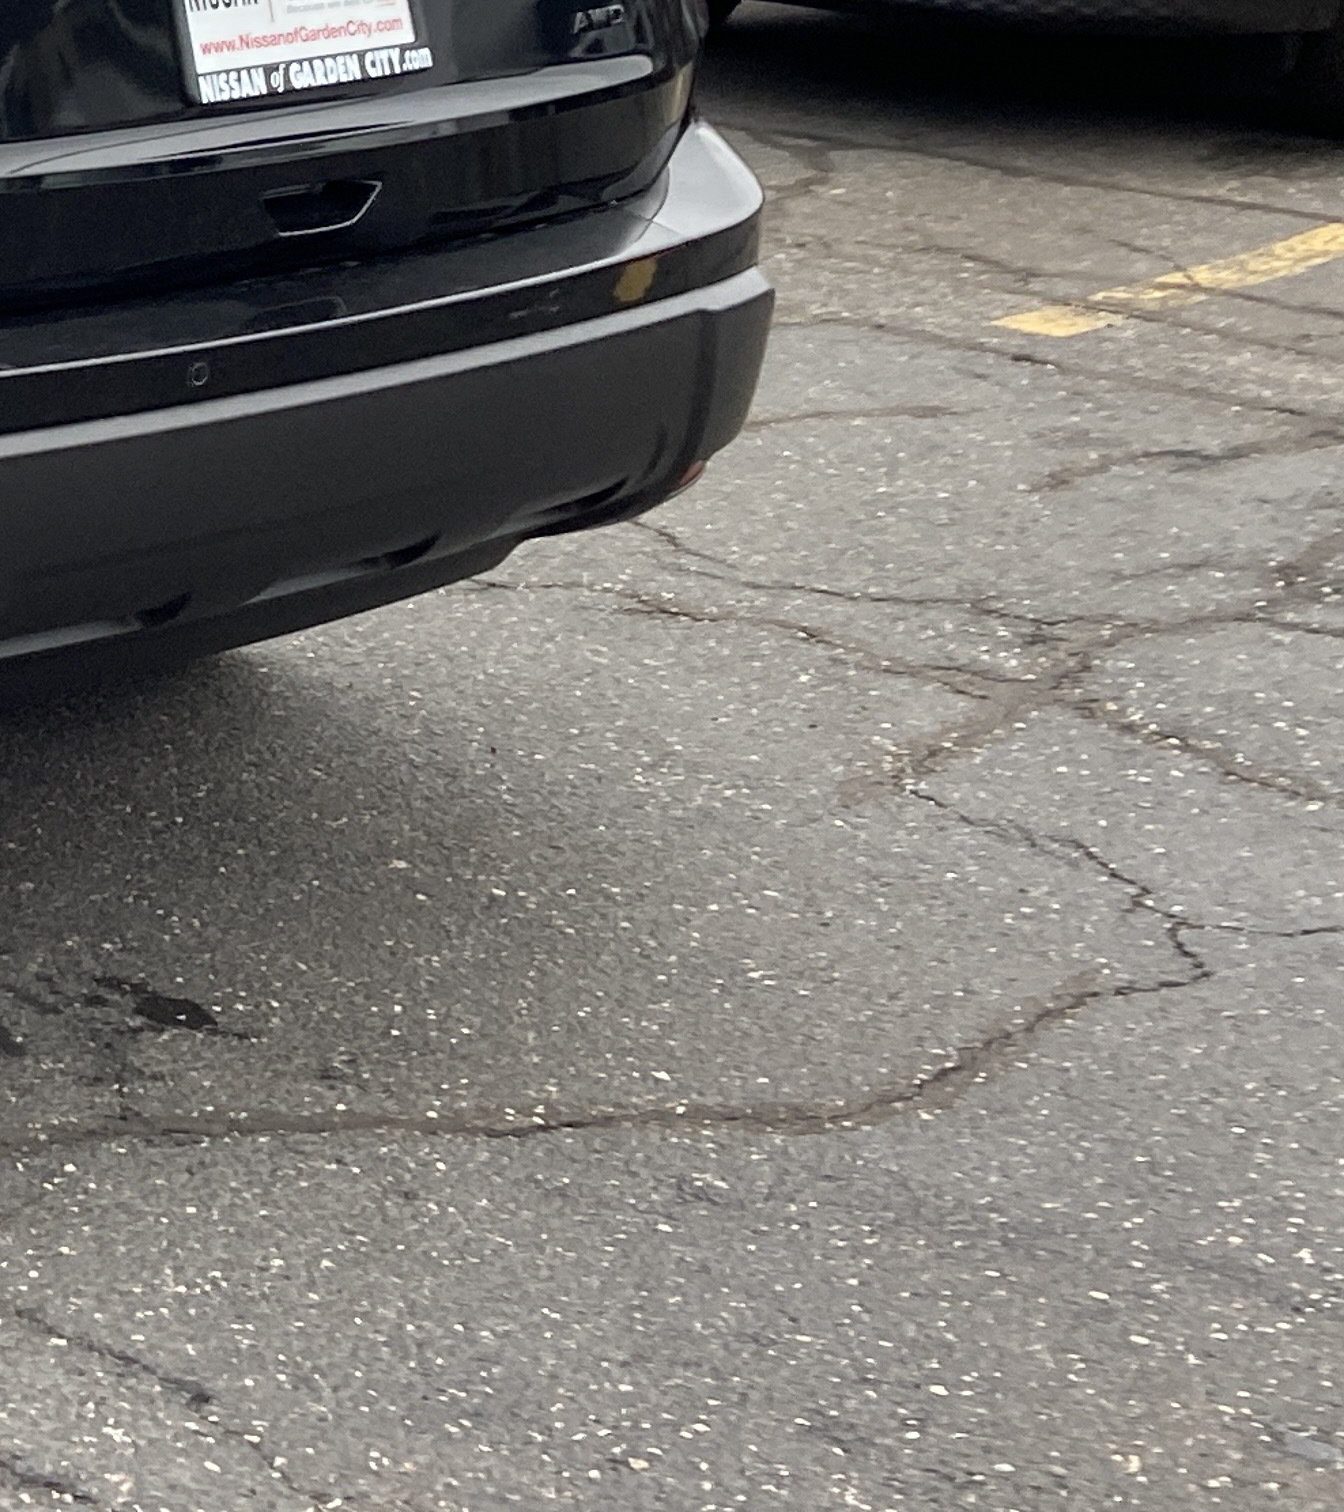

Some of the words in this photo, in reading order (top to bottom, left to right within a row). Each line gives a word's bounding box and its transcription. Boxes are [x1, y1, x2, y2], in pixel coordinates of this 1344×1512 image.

[199, 17, 404, 55] www.NissanofGardenCity.com
[198, 65, 268, 104] NISSAN
[270, 63, 286, 93] of
[289, 54, 362, 89] GARDEN
